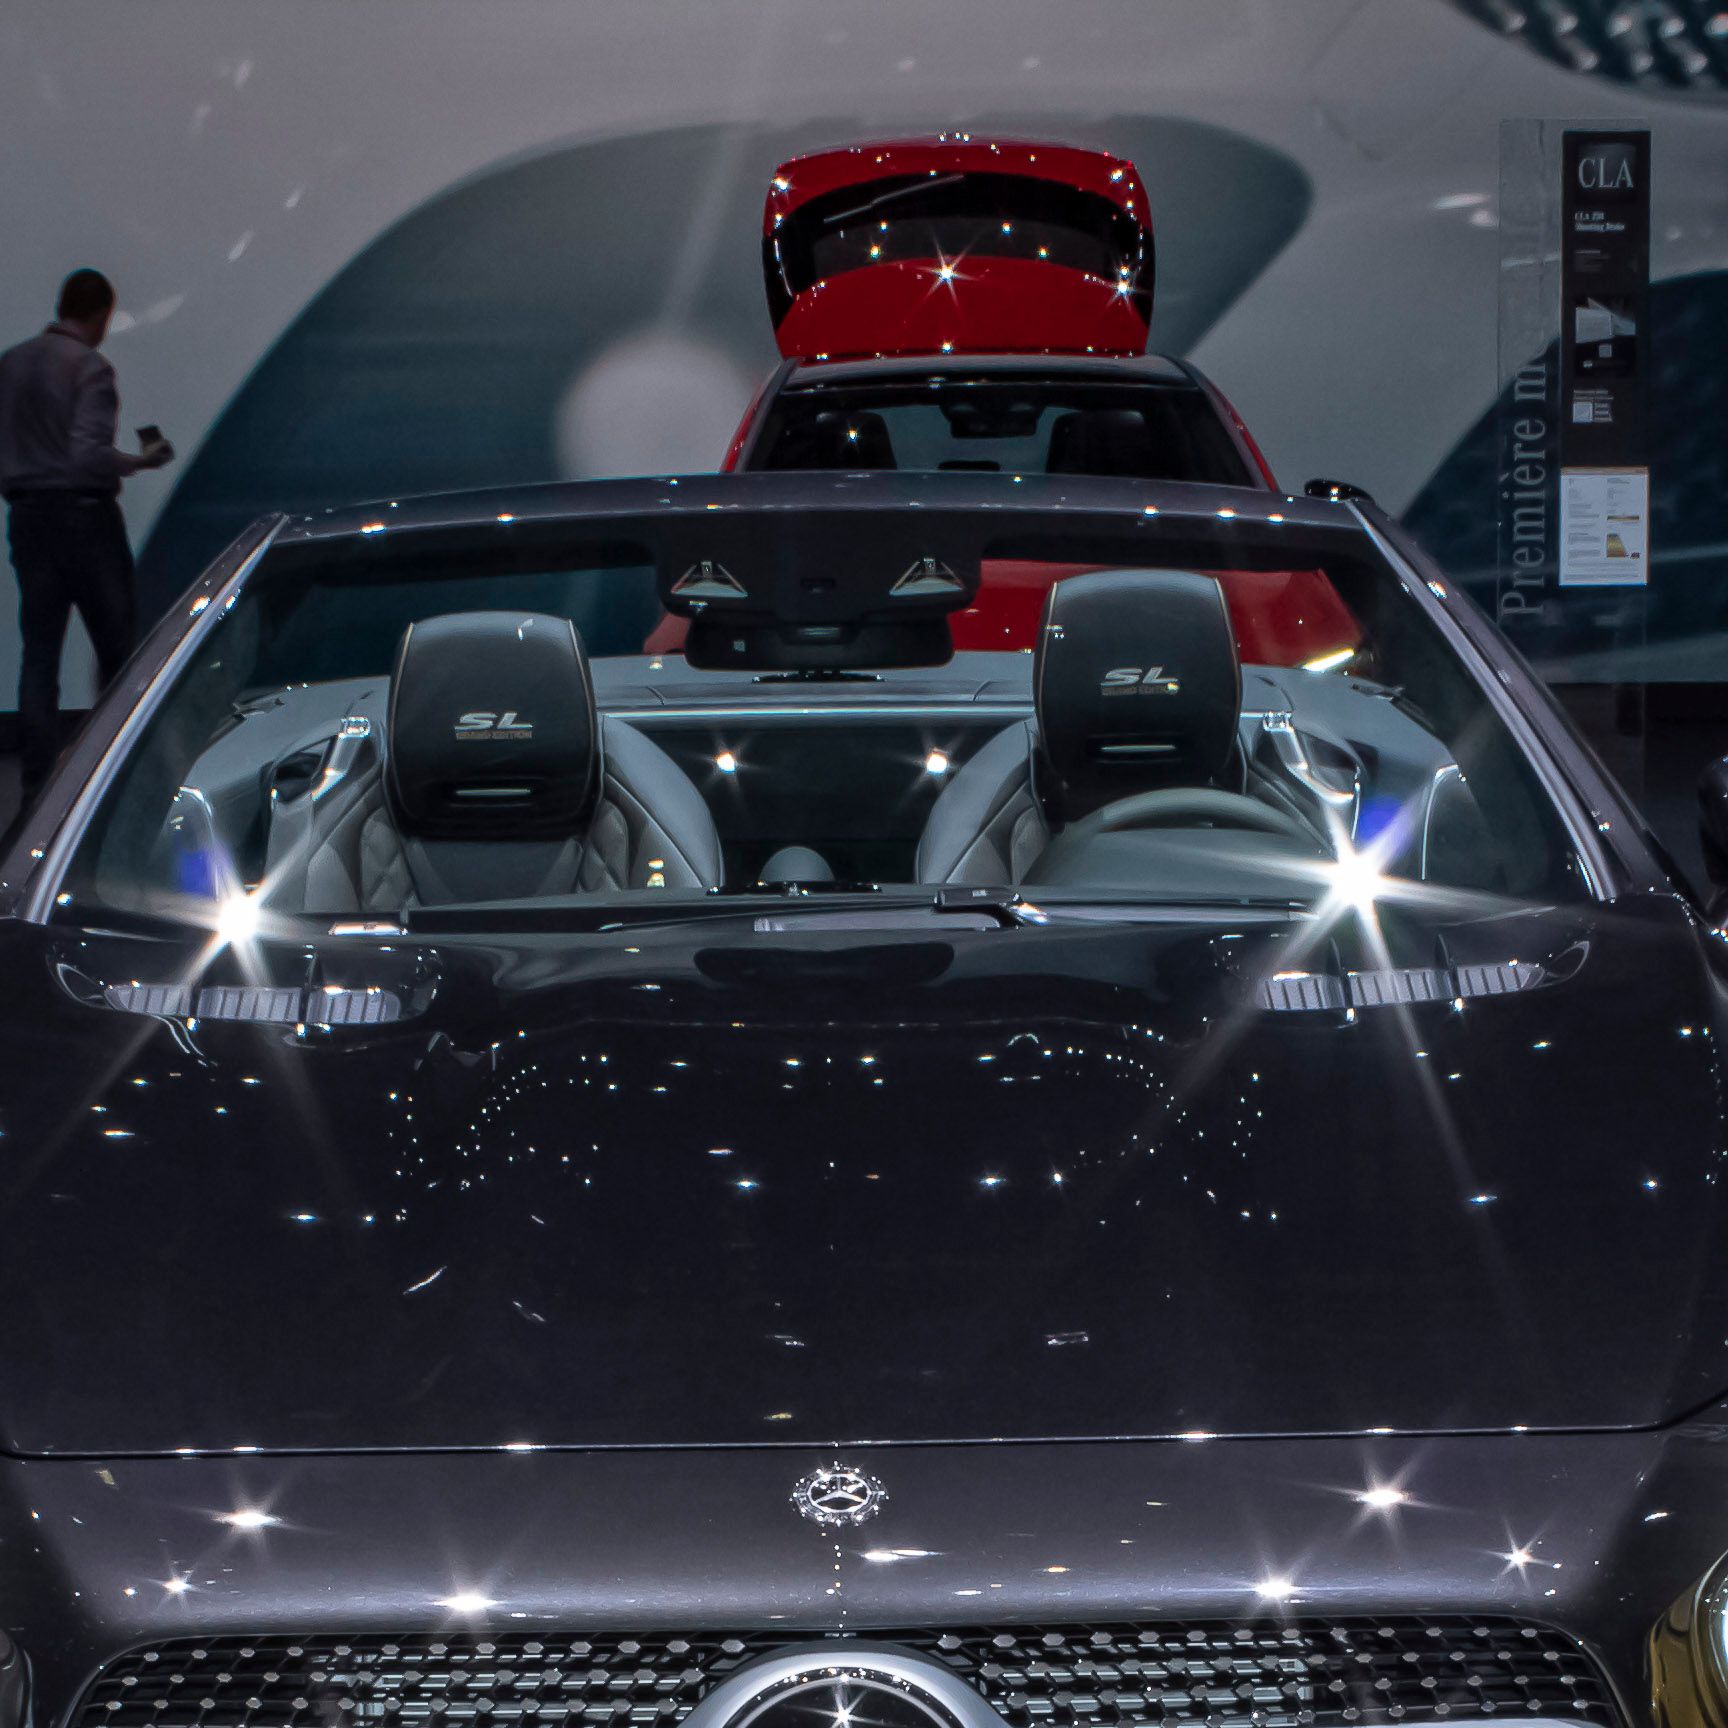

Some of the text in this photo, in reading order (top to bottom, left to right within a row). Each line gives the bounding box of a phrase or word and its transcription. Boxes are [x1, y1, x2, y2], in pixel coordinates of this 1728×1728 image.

[1578, 158, 1634, 189] CLA
[1100, 666, 1179, 686] SL
[454, 712, 534, 730] SL
